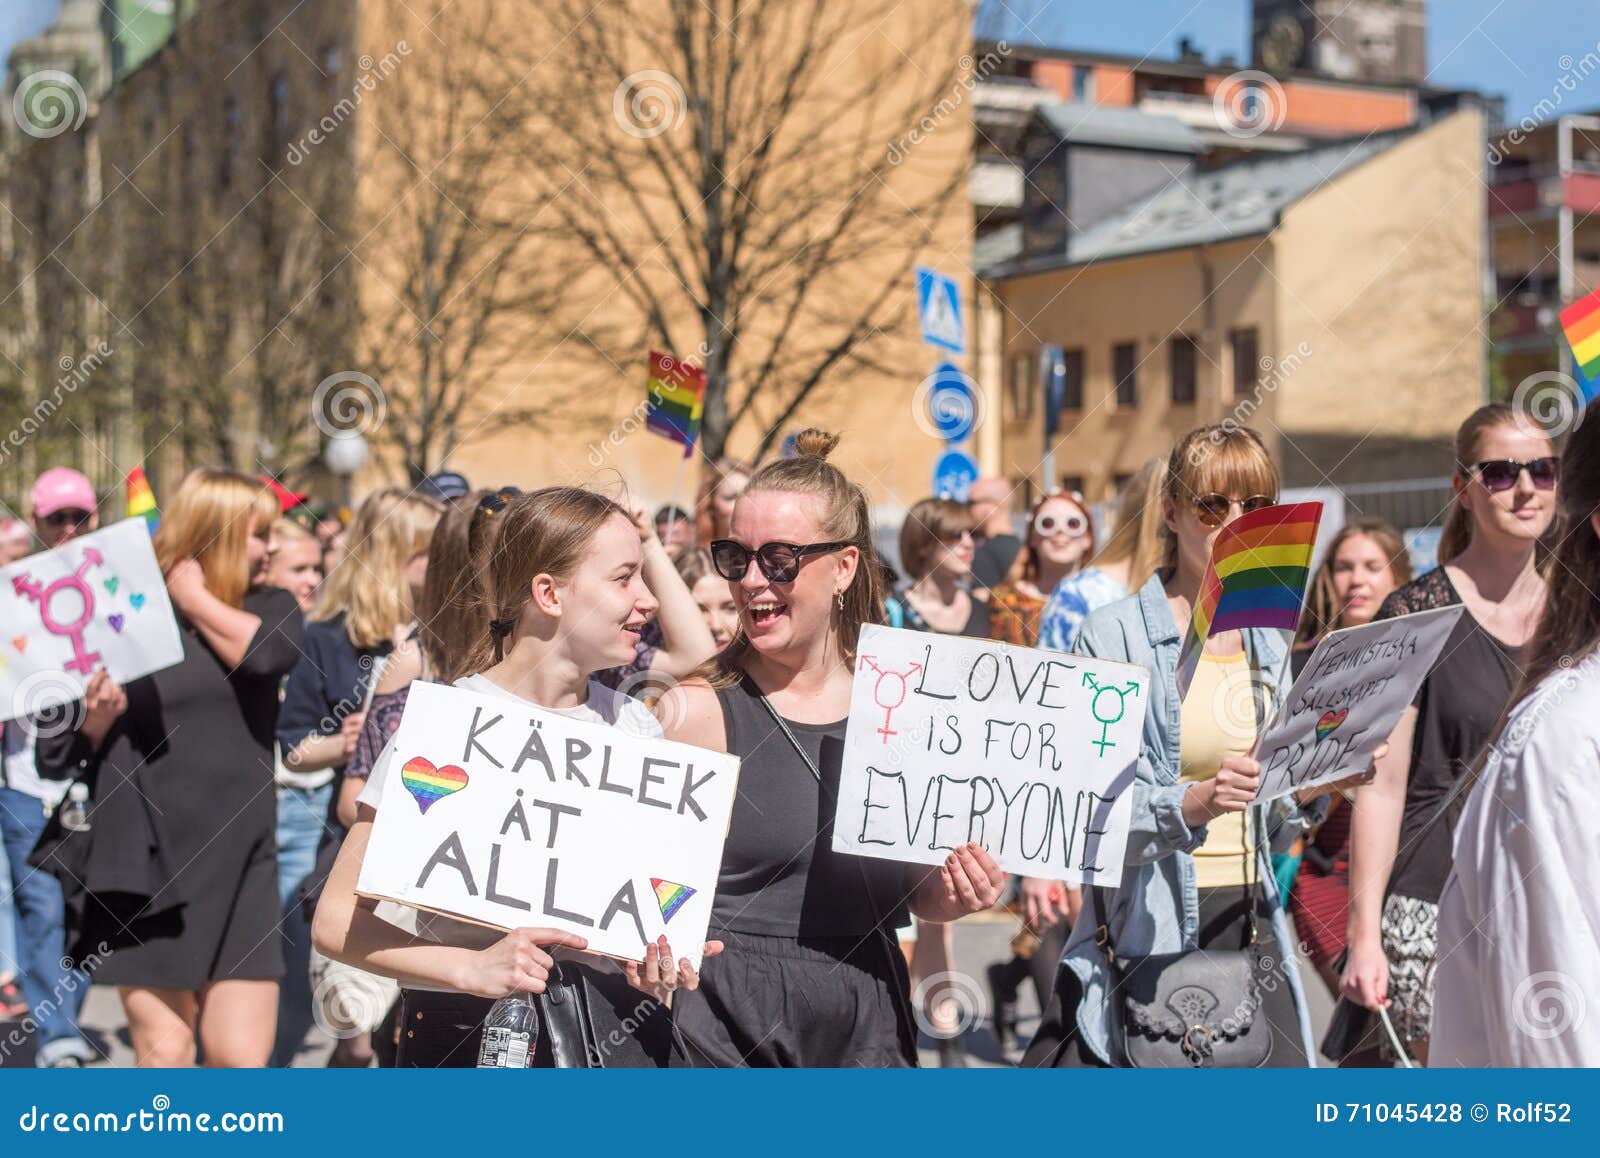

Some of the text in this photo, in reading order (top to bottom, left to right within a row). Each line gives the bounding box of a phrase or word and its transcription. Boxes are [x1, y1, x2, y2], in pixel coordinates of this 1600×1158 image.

[914, 645, 1076, 709] LOVE
[463, 706, 717, 823] KÄRLEK
[927, 715, 1062, 771] IS FOR
[1255, 728, 1370, 798] PRIDE
[499, 788, 583, 849] ÅT
[858, 766, 1116, 872] EVERYONE
[415, 830, 649, 947] ALLA
